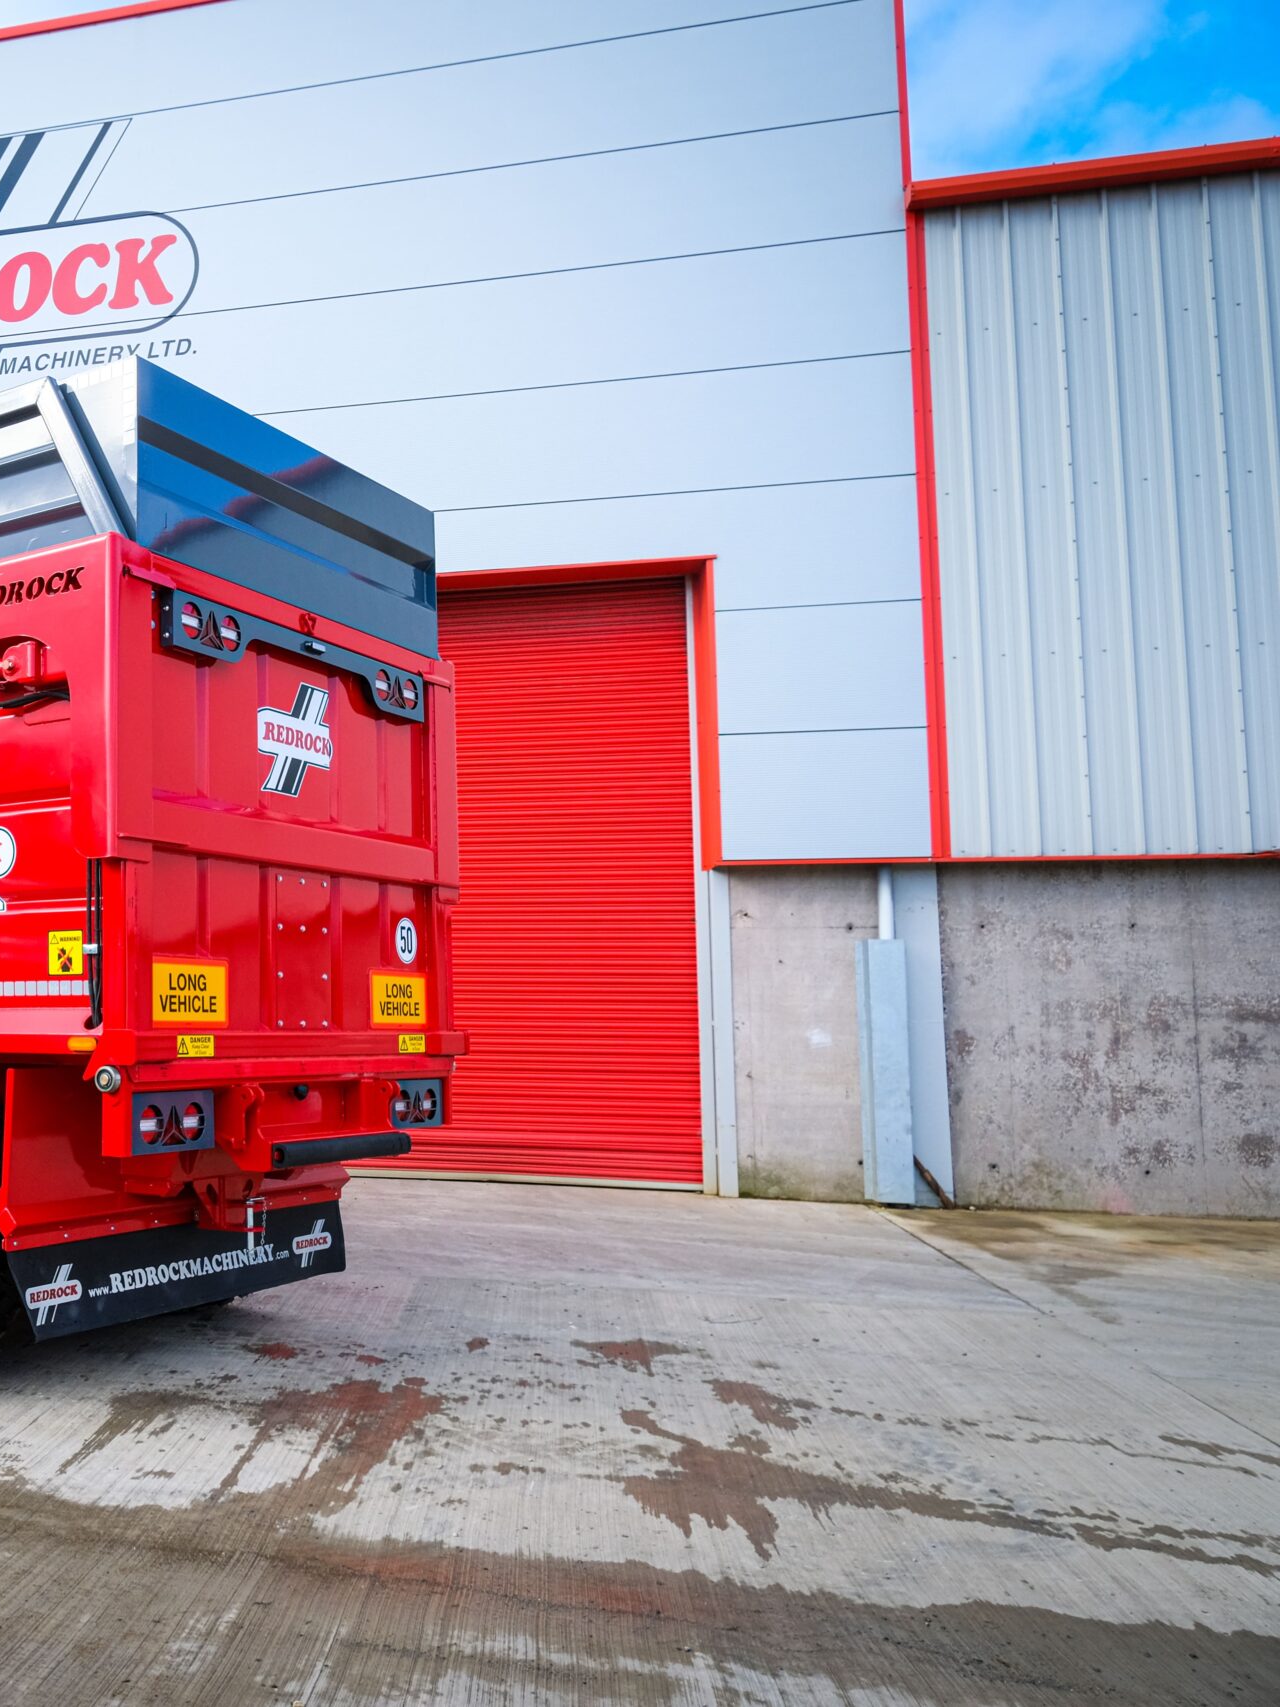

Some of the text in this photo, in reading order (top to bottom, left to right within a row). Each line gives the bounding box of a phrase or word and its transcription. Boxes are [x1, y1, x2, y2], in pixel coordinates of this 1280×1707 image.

[147, 338, 198, 359] LTD.
[263, 721, 331, 757] REDROCK
[400, 926, 413, 954] 50
[169, 973, 207, 992] LONG
[385, 984, 412, 998] LONG
[159, 995, 217, 1013] VEHICLE
[380, 1002, 420, 1016] VEHICLE
[296, 1235, 329, 1250] REDROCK
[29, 1284, 79, 1304] REDROCK
